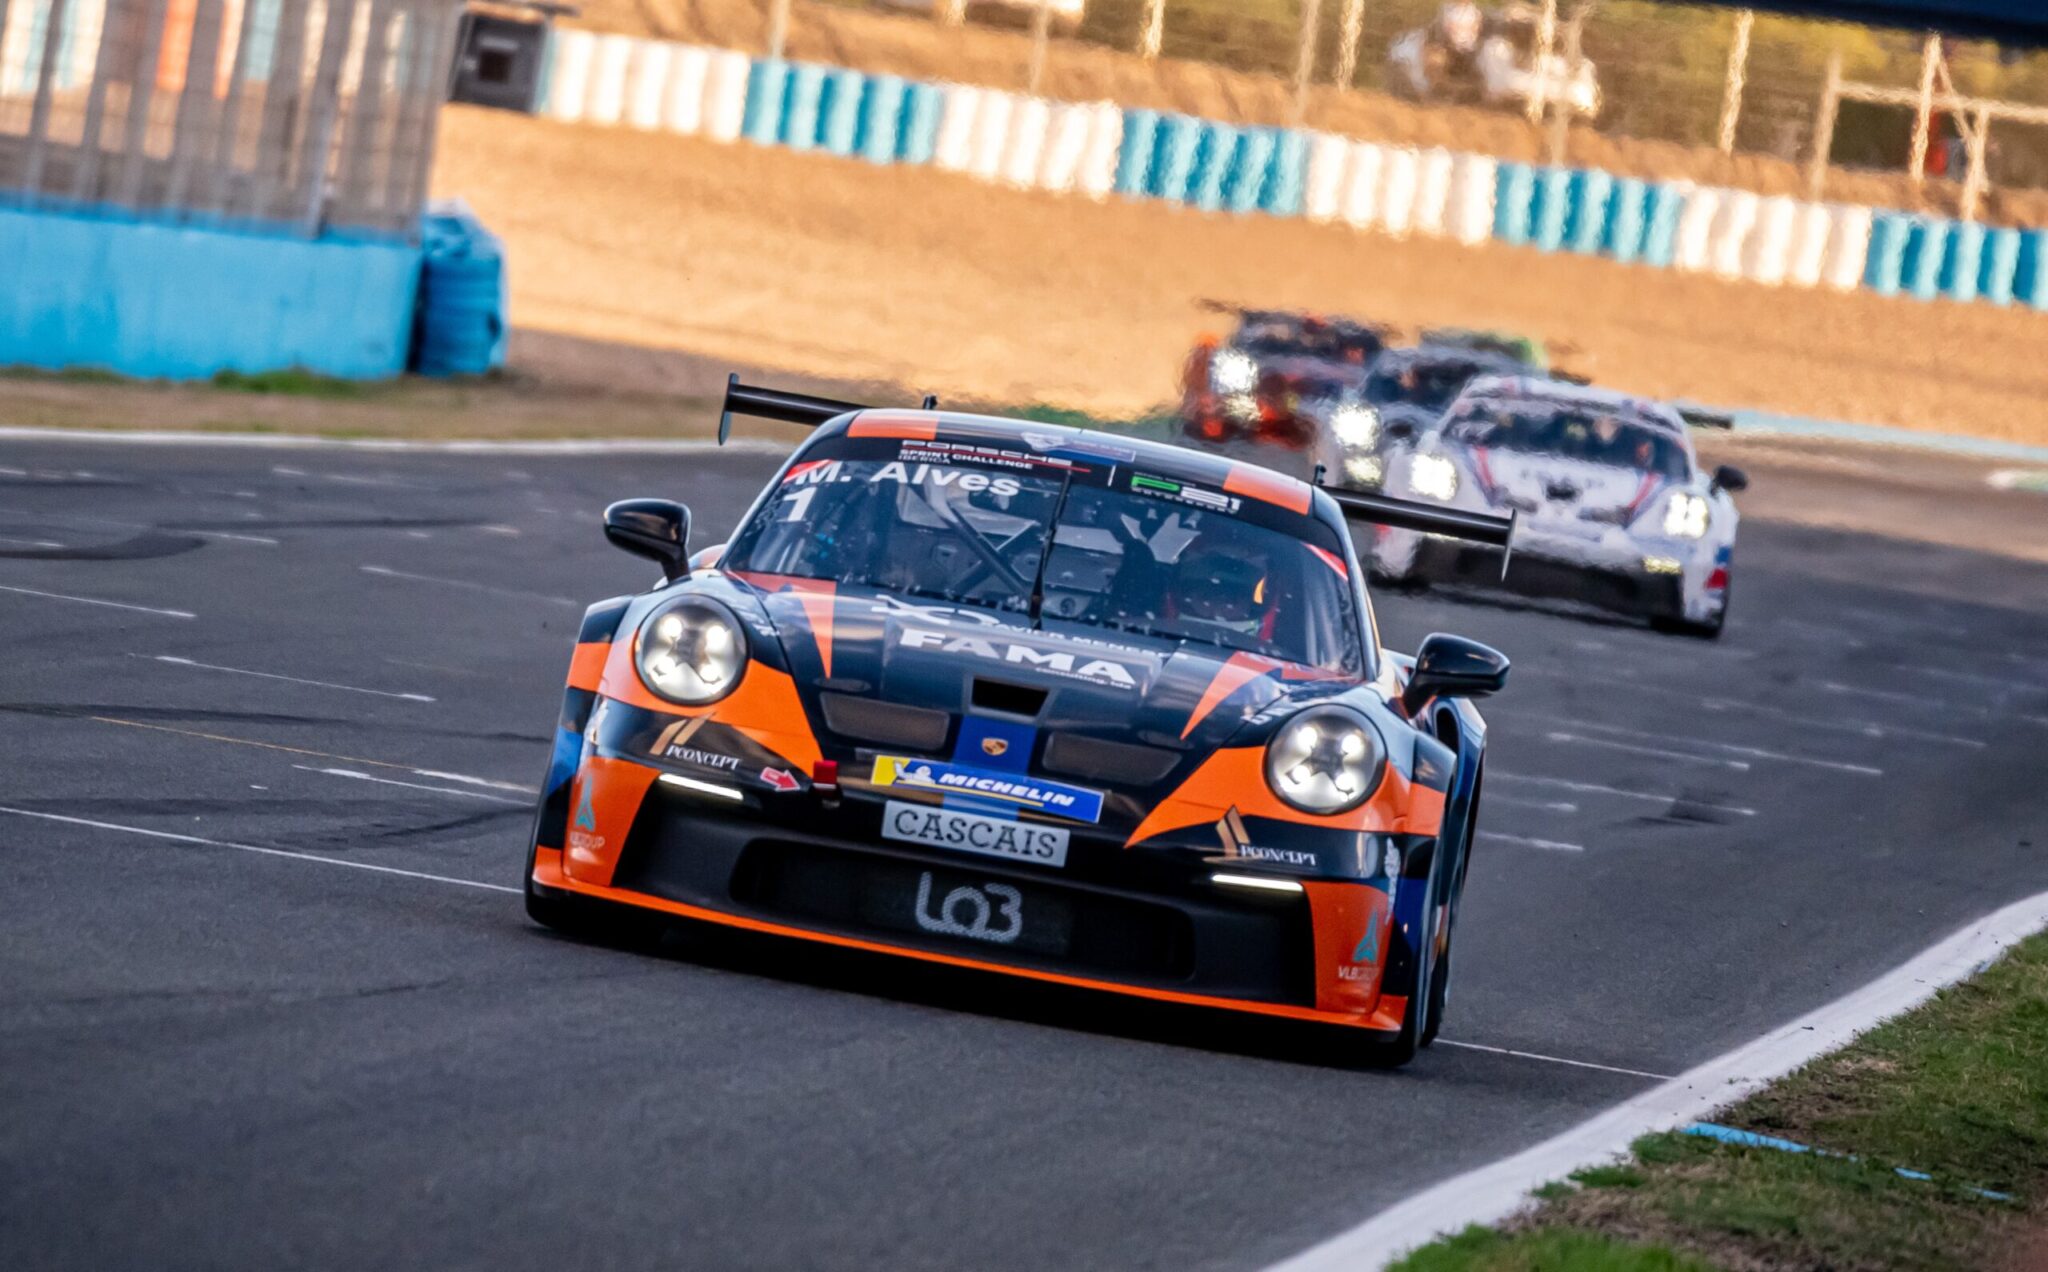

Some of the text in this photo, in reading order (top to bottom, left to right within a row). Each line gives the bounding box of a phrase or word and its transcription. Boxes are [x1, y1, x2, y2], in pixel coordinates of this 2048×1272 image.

[900, 448, 1033, 470] SPRINT CHALLENGE
[902, 439, 1072, 467] PORSCHE
[796, 461, 1021, 497] M. Alves
[777, 486, 818, 523] 1
[900, 628, 1136, 685] FAMA
[939, 773, 1076, 808] MICHELIN
[894, 809, 1059, 859] CASCAIS
